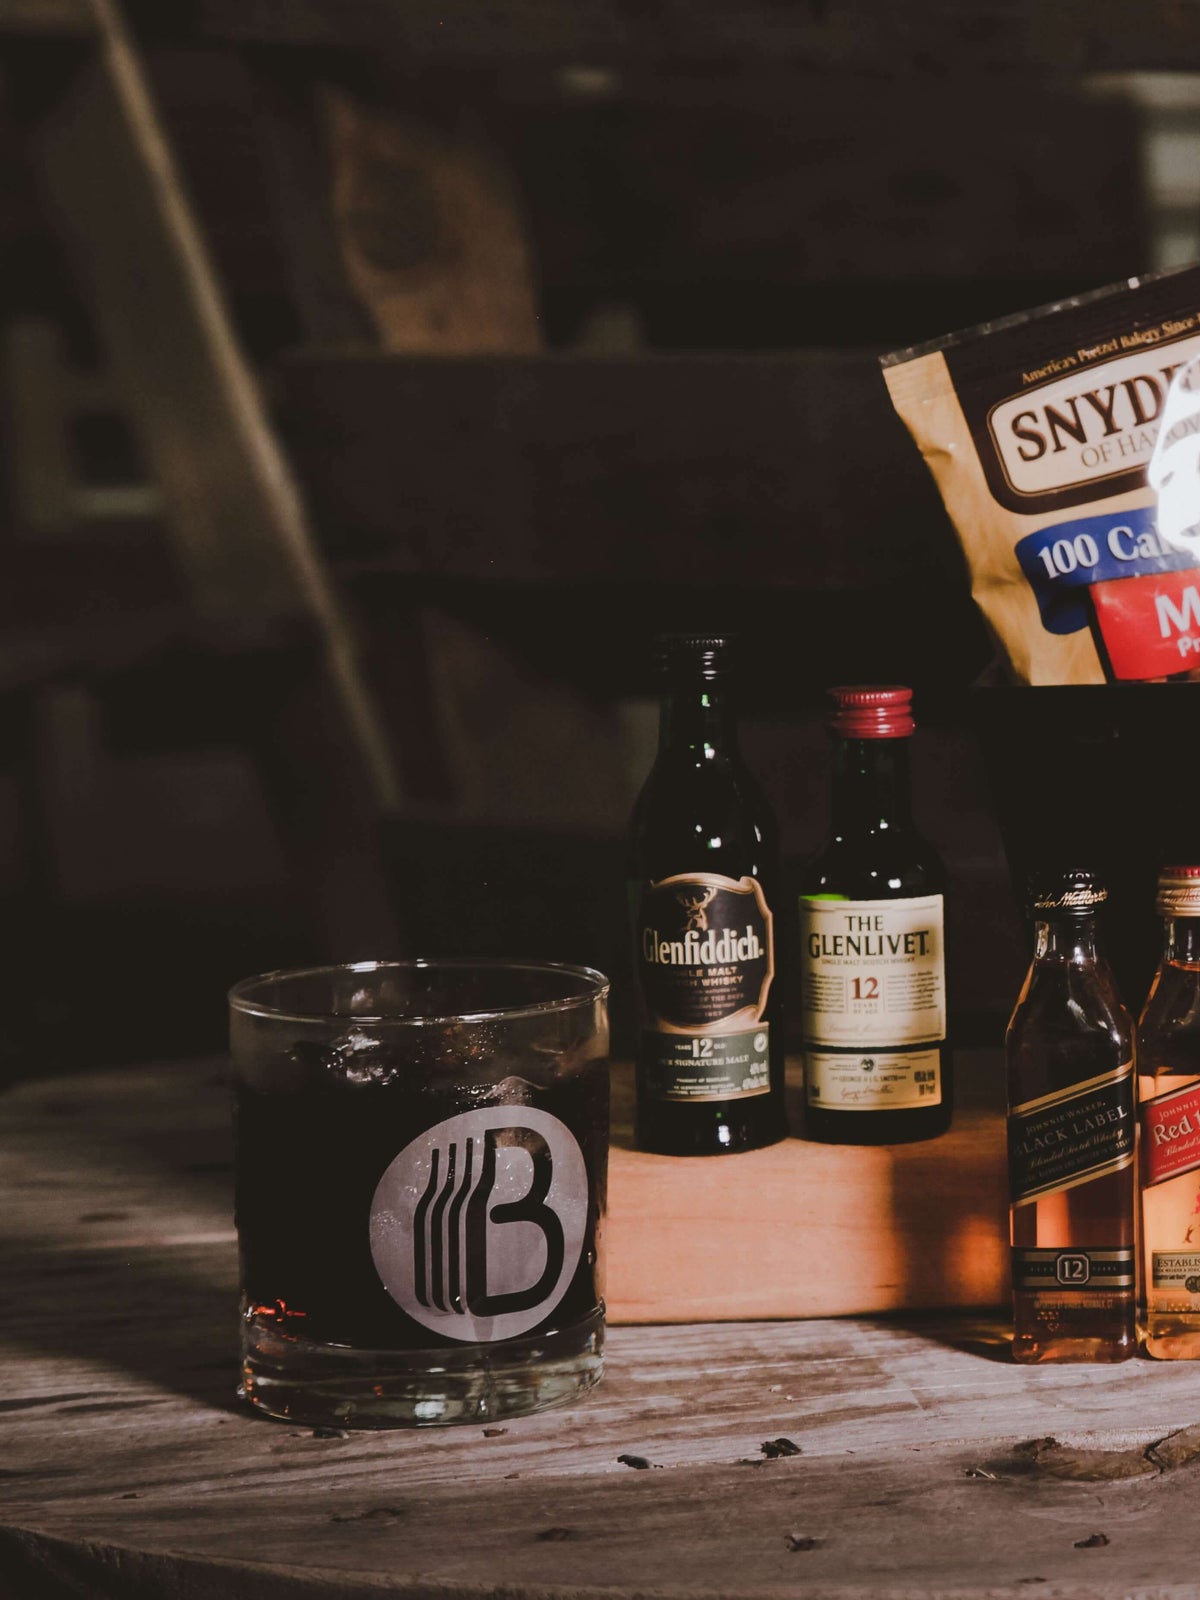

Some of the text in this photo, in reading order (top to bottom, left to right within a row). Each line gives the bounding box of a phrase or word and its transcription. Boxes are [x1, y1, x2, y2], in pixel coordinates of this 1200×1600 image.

[1077, 338, 1119, 362] Pretzel
[1080, 444, 1113, 468] OF
[1037, 534, 1099, 579] 100
[844, 915, 883, 931] THE
[701, 975, 744, 987] WHISKY
[708, 966, 738, 977] MALT
[851, 976, 879, 1000] 12
[692, 1038, 713, 1058] 12
[676, 1057, 724, 1067] SIGNATURE
[726, 1054, 750, 1065] MALT
[1160, 1100, 1199, 1121] JOHNNIE
[1016, 1130, 1068, 1155] LACK
[1072, 1105, 1128, 1135] LABEL
[1153, 1115, 1194, 1146] Red
[1063, 1261, 1083, 1279] 12
